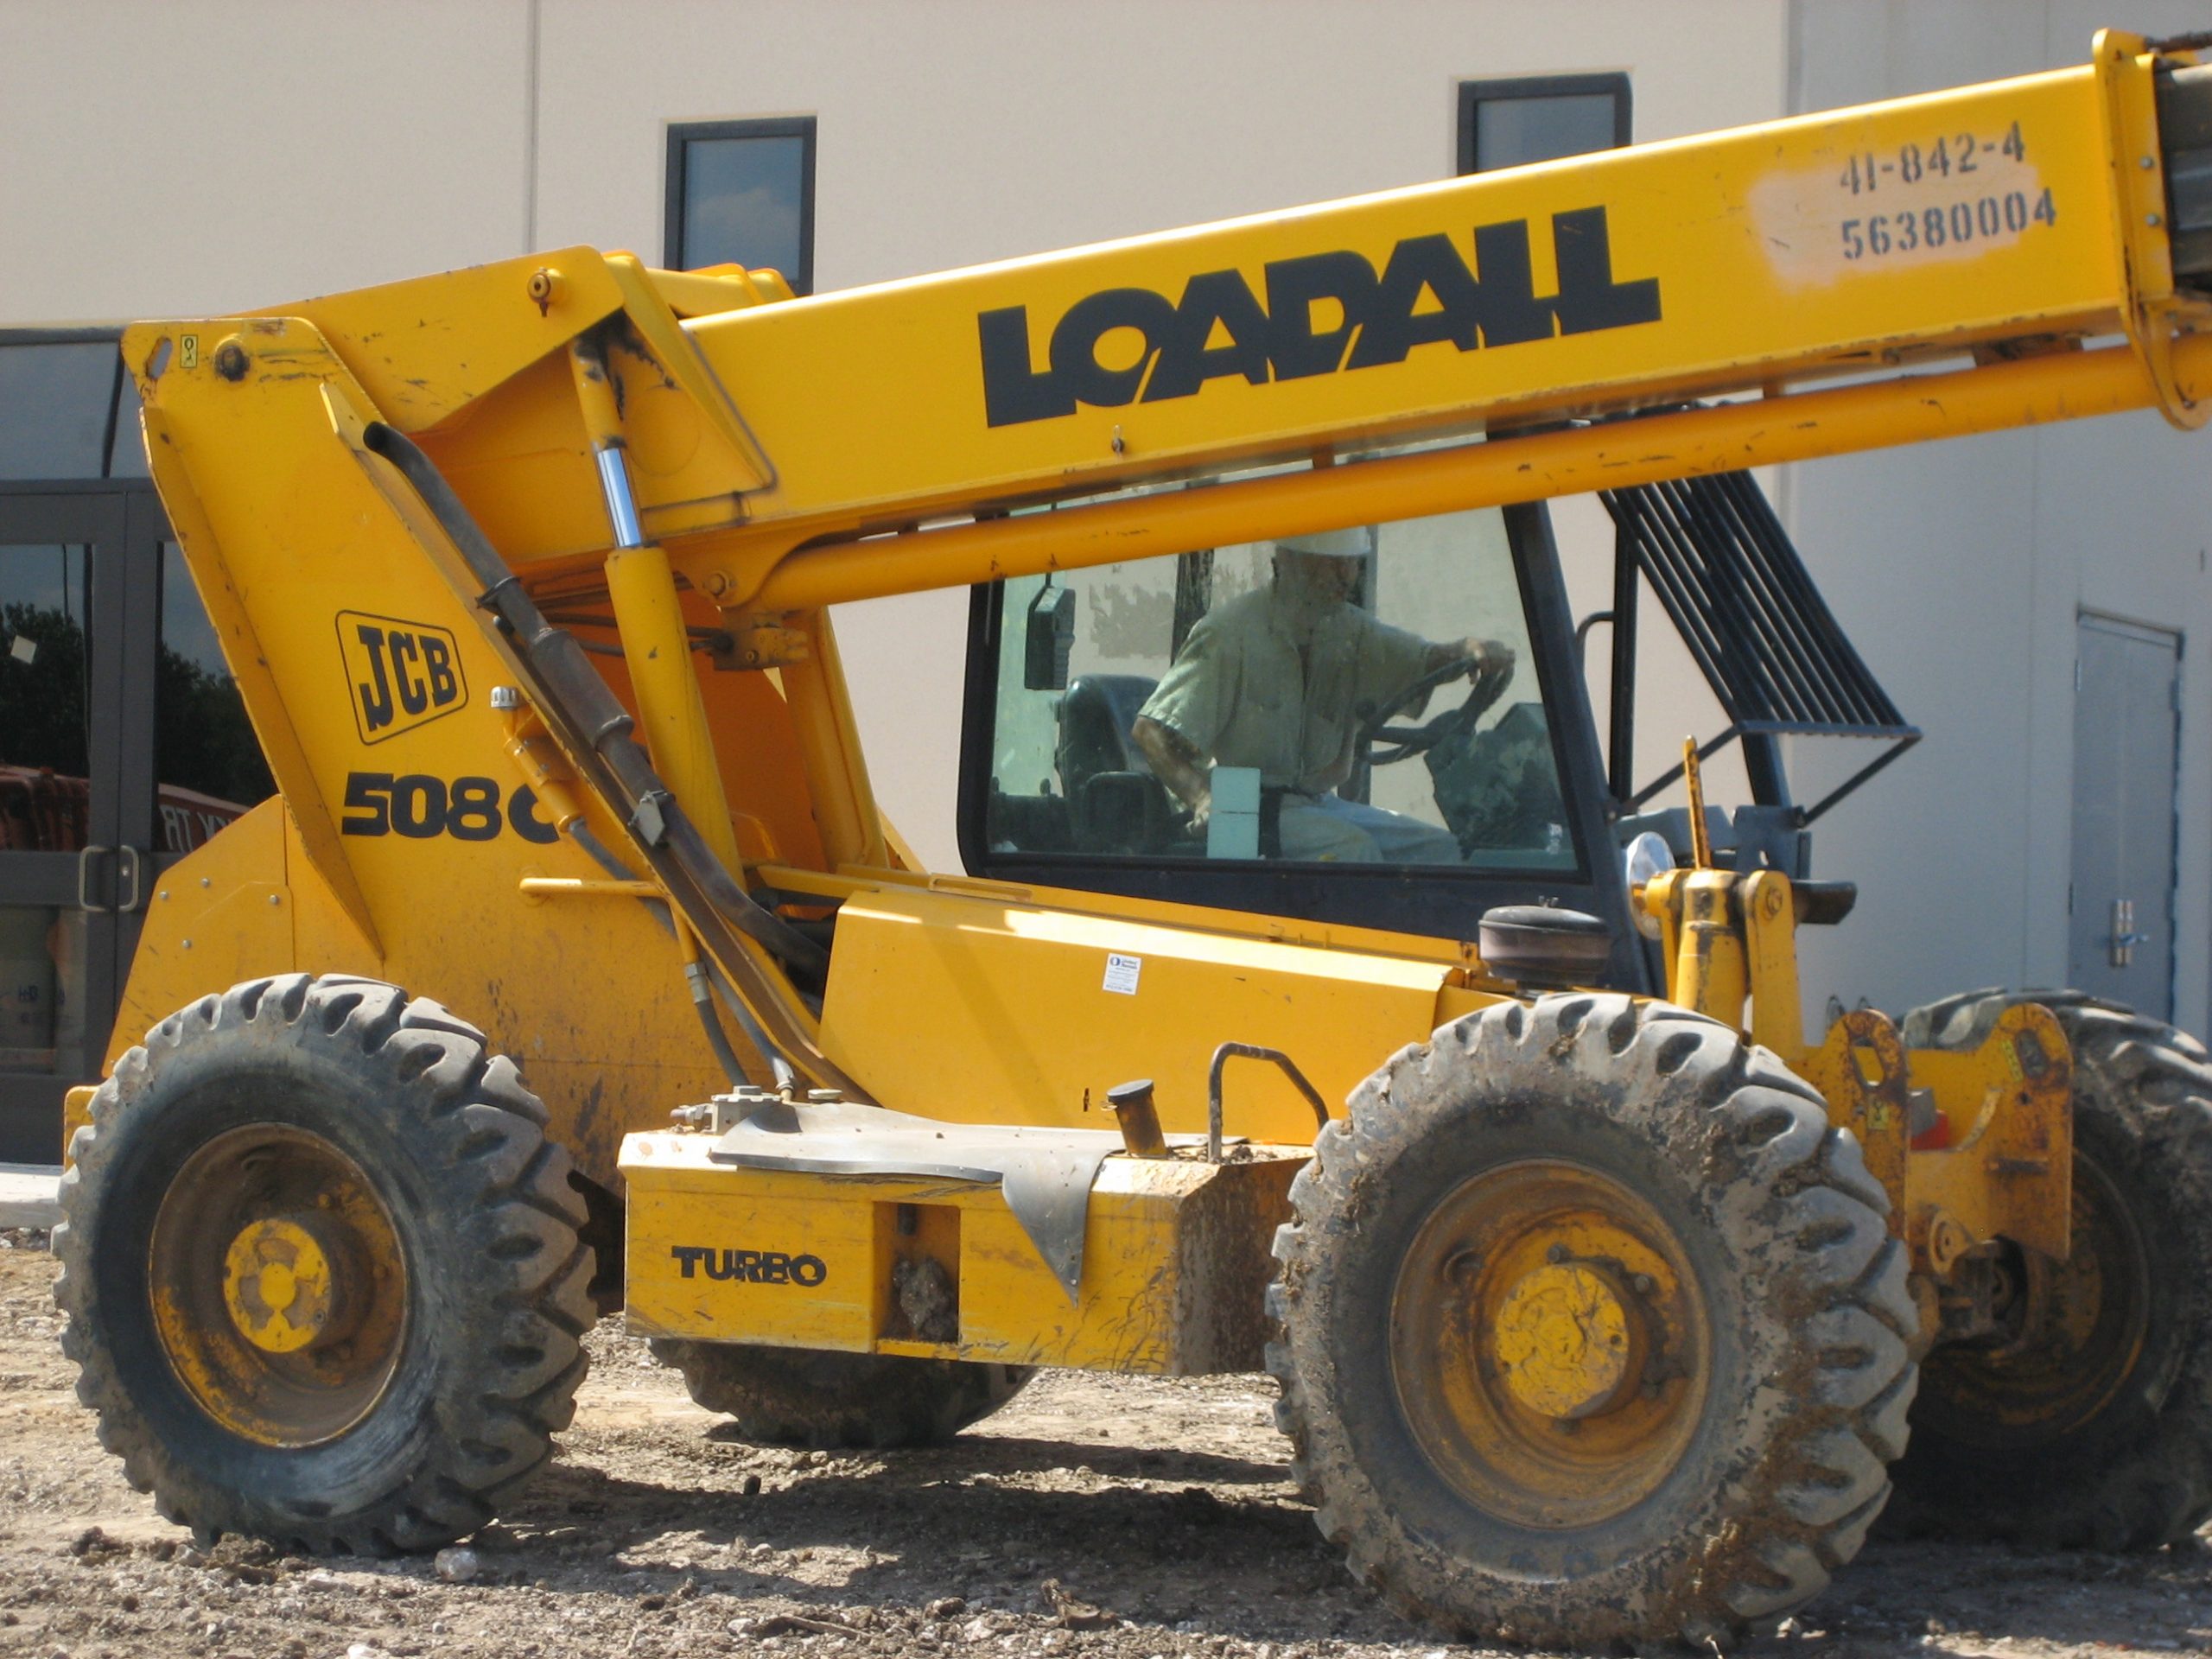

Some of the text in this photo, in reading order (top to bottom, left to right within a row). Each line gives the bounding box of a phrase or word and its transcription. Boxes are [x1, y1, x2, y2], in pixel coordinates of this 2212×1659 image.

[1840, 120, 2024, 195] 41-842-4
[1841, 187, 2056, 259] 56380004
[978, 205, 1662, 428] LOADALL
[356, 624, 458, 732] JCB
[671, 1245, 827, 1287] TURBO
